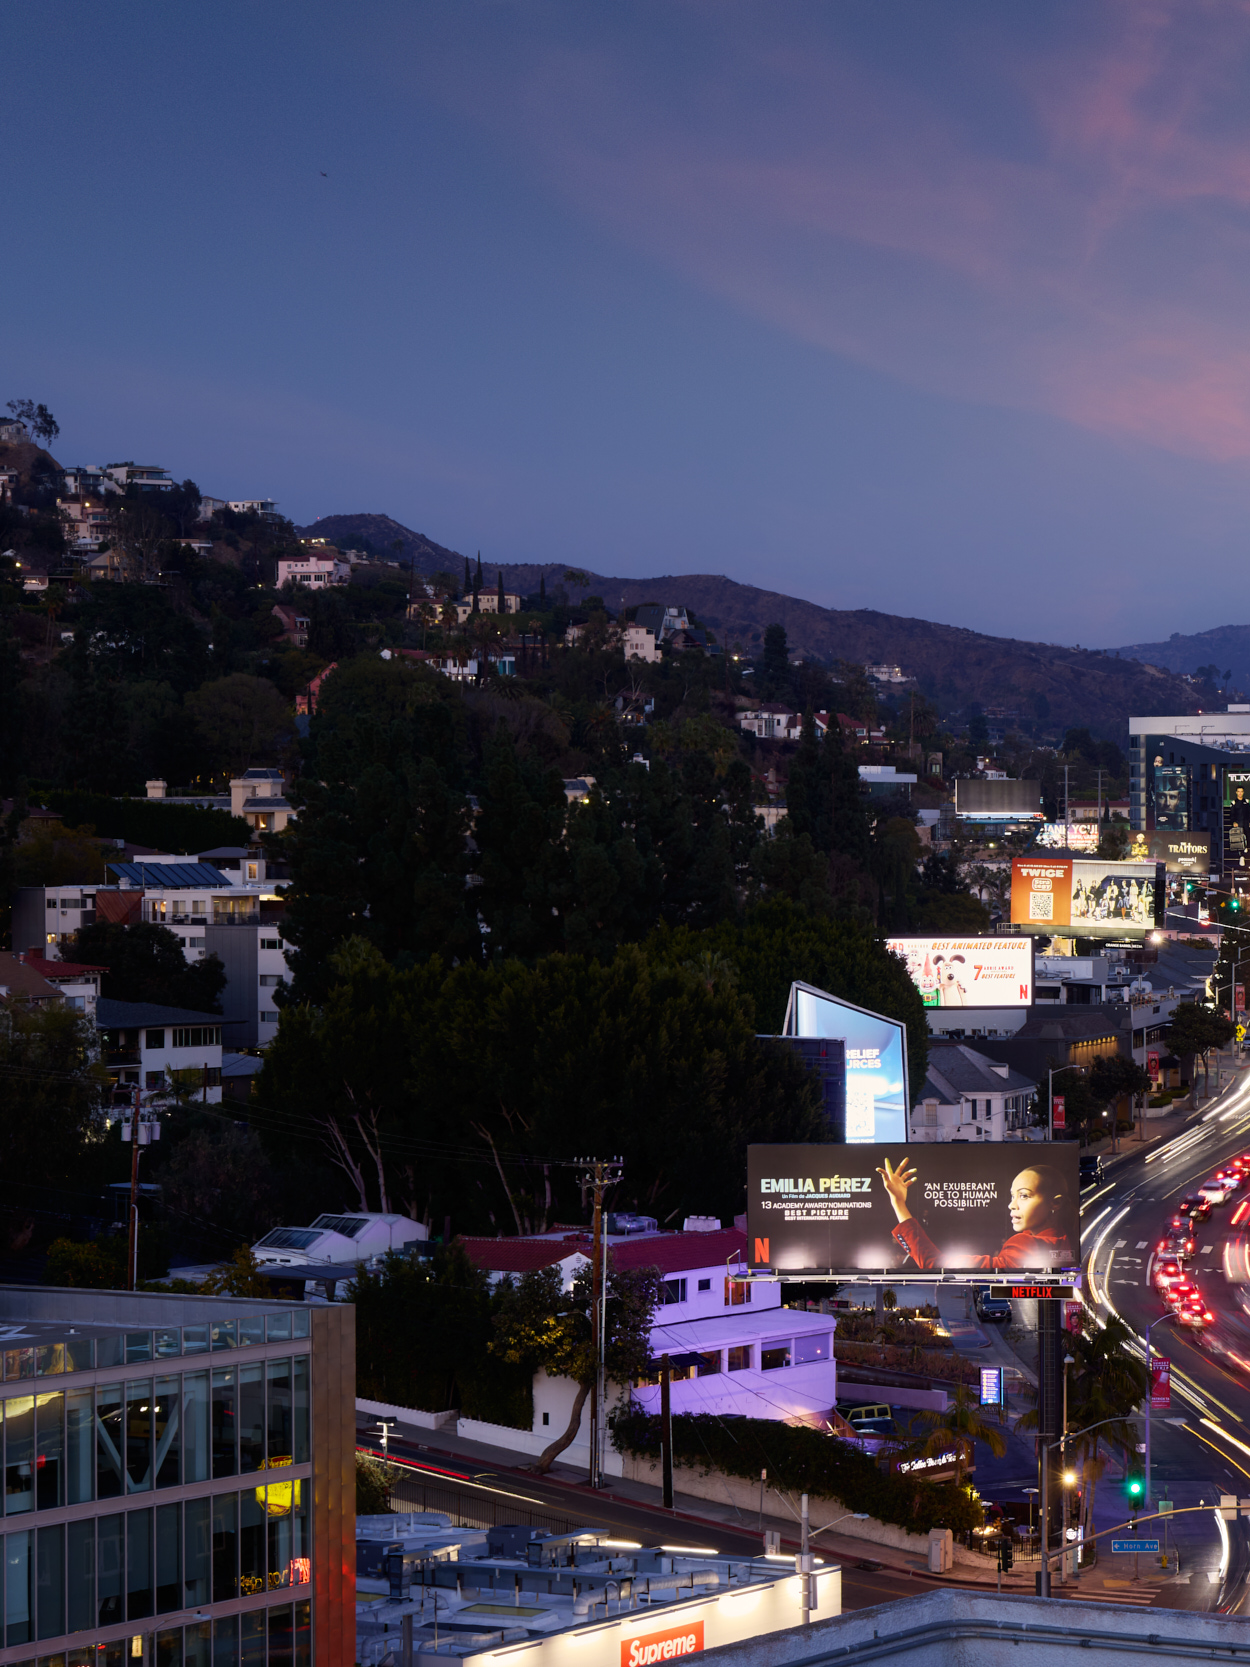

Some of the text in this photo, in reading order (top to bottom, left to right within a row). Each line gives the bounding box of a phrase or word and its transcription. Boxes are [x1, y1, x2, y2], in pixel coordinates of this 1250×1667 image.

[1168, 843, 1208, 854] TRAITORS
[932, 942, 950, 950] BEST
[951, 942, 992, 950] ANIMATED
[993, 942, 1028, 950] FEATURE
[974, 965, 982, 980] 7
[1020, 984, 1028, 999] N
[760, 1175, 872, 1193] EMILIA PÉREZ
[943, 1182, 996, 1191] EXUBERANT
[924, 1190, 998, 1200] ODE TO HUMAN
[754, 1238, 770, 1263] N
[1012, 1286, 1052, 1298] NETFLIX
[628, 1634, 696, 1667] Supreme
